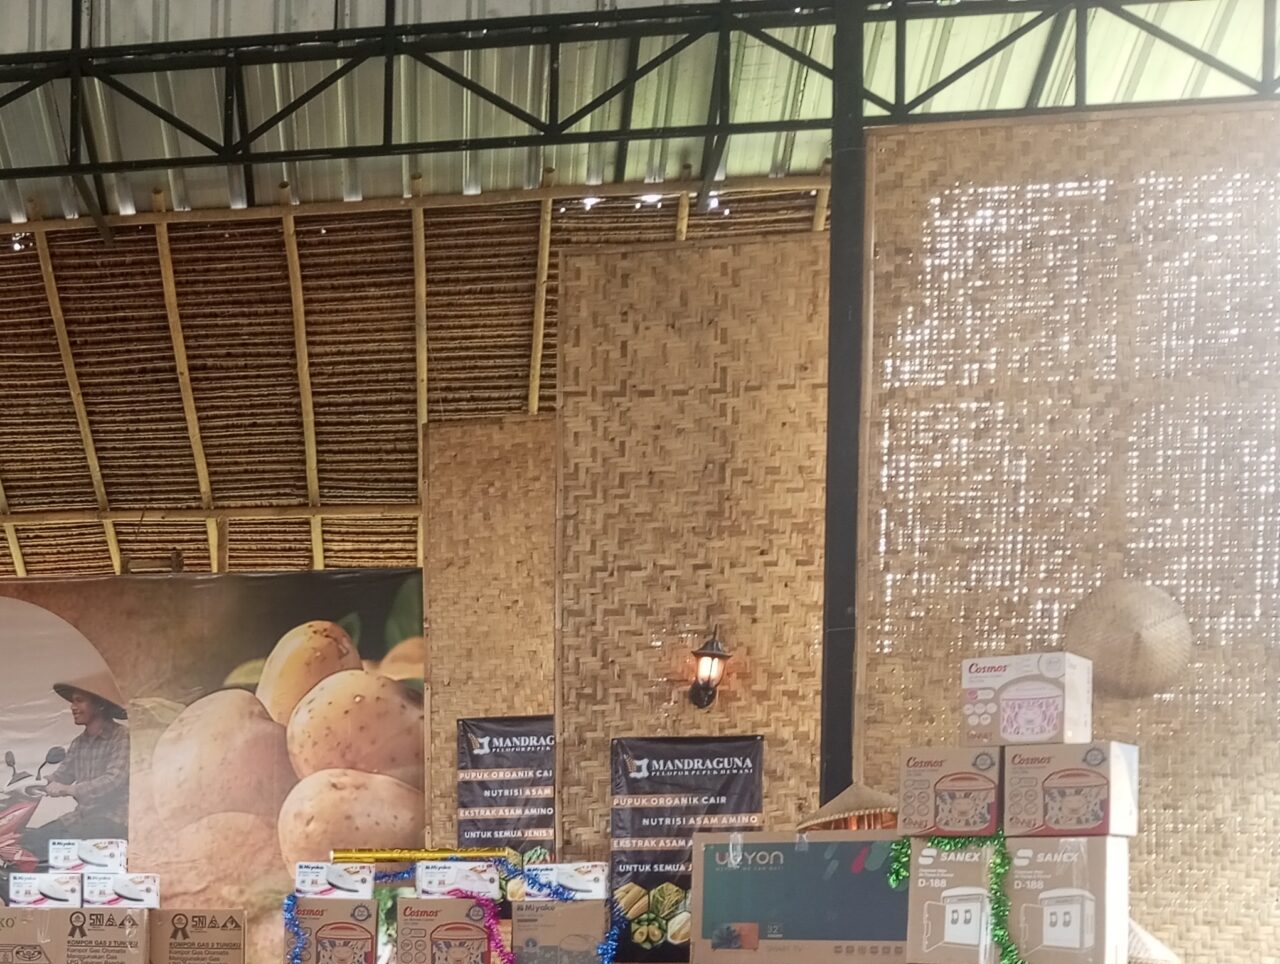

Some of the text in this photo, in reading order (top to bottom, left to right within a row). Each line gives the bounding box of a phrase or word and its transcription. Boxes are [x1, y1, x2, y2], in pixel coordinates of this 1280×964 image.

[968, 662, 1008, 674] Cosmos
[652, 757, 753, 770] MANDRAGUNA
[906, 756, 946, 768] Cosmos
[1011, 754, 1052, 766] Cosmos
[460, 772, 489, 780] PUPUK
[491, 770, 534, 778] ORGANIK
[484, 787, 552, 797] NUTRISI ASAM
[613, 796, 727, 806] PUPUK ORGANIK CAIR
[460, 807, 554, 817] EKSTRAK ASAM AMINO
[688, 816, 719, 825] ASAM
[721, 815, 758, 824] AMINO
[465, 829, 547, 838] UNTUK SEMUA JENIS
[613, 839, 686, 848] EKSTRAK ASAM
[940, 853, 982, 862] SANEX
[1036, 852, 1079, 863] SANEX
[619, 863, 686, 872] UNTUK SEMUA
[918, 879, 947, 888] D-188
[1014, 880, 1044, 889] D-188
[296, 906, 325, 916] osmos
[403, 906, 439, 917] Cosmos
[525, 904, 556, 912] Miyako
[89, 914, 104, 926] SNI
[192, 916, 206, 928] SNI
